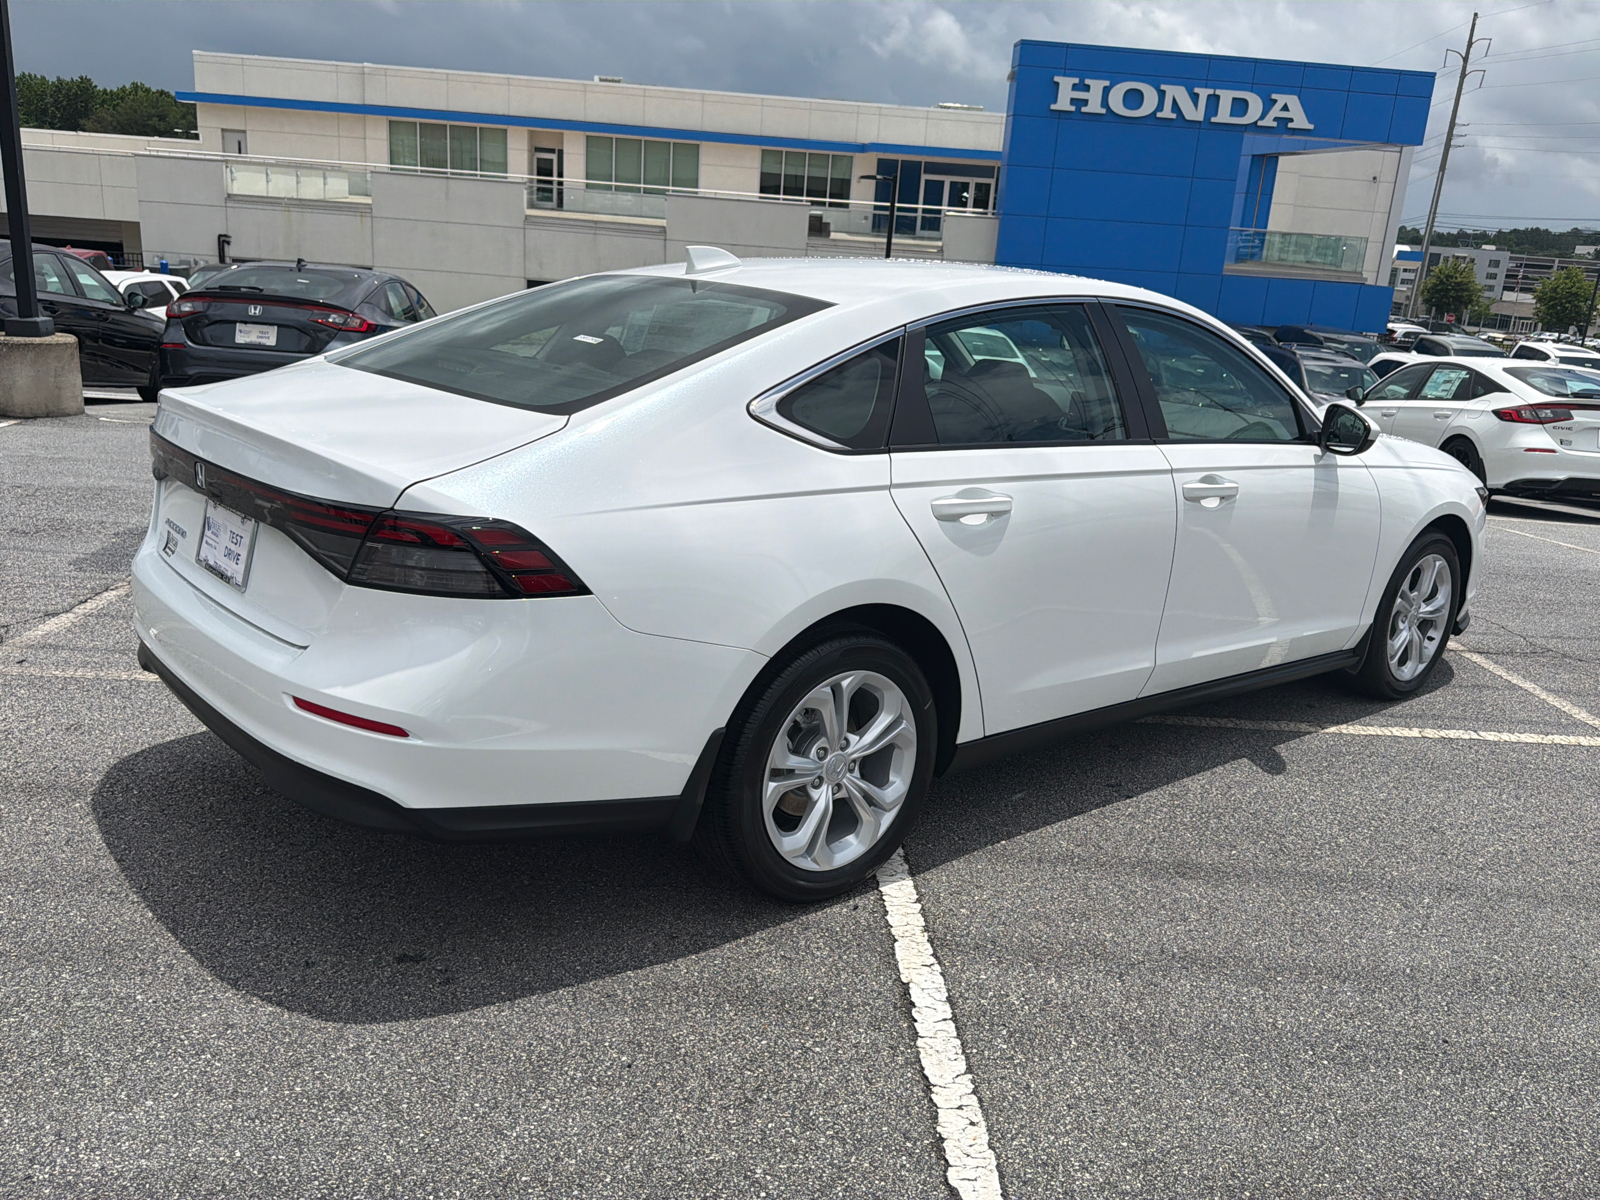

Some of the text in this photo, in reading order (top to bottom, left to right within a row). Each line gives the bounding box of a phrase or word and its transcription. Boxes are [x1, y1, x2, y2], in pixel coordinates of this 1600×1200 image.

[1049, 75, 1315, 130] HONDA
[229, 529, 244, 547] TEST
[223, 545, 242, 566] DRIVE
